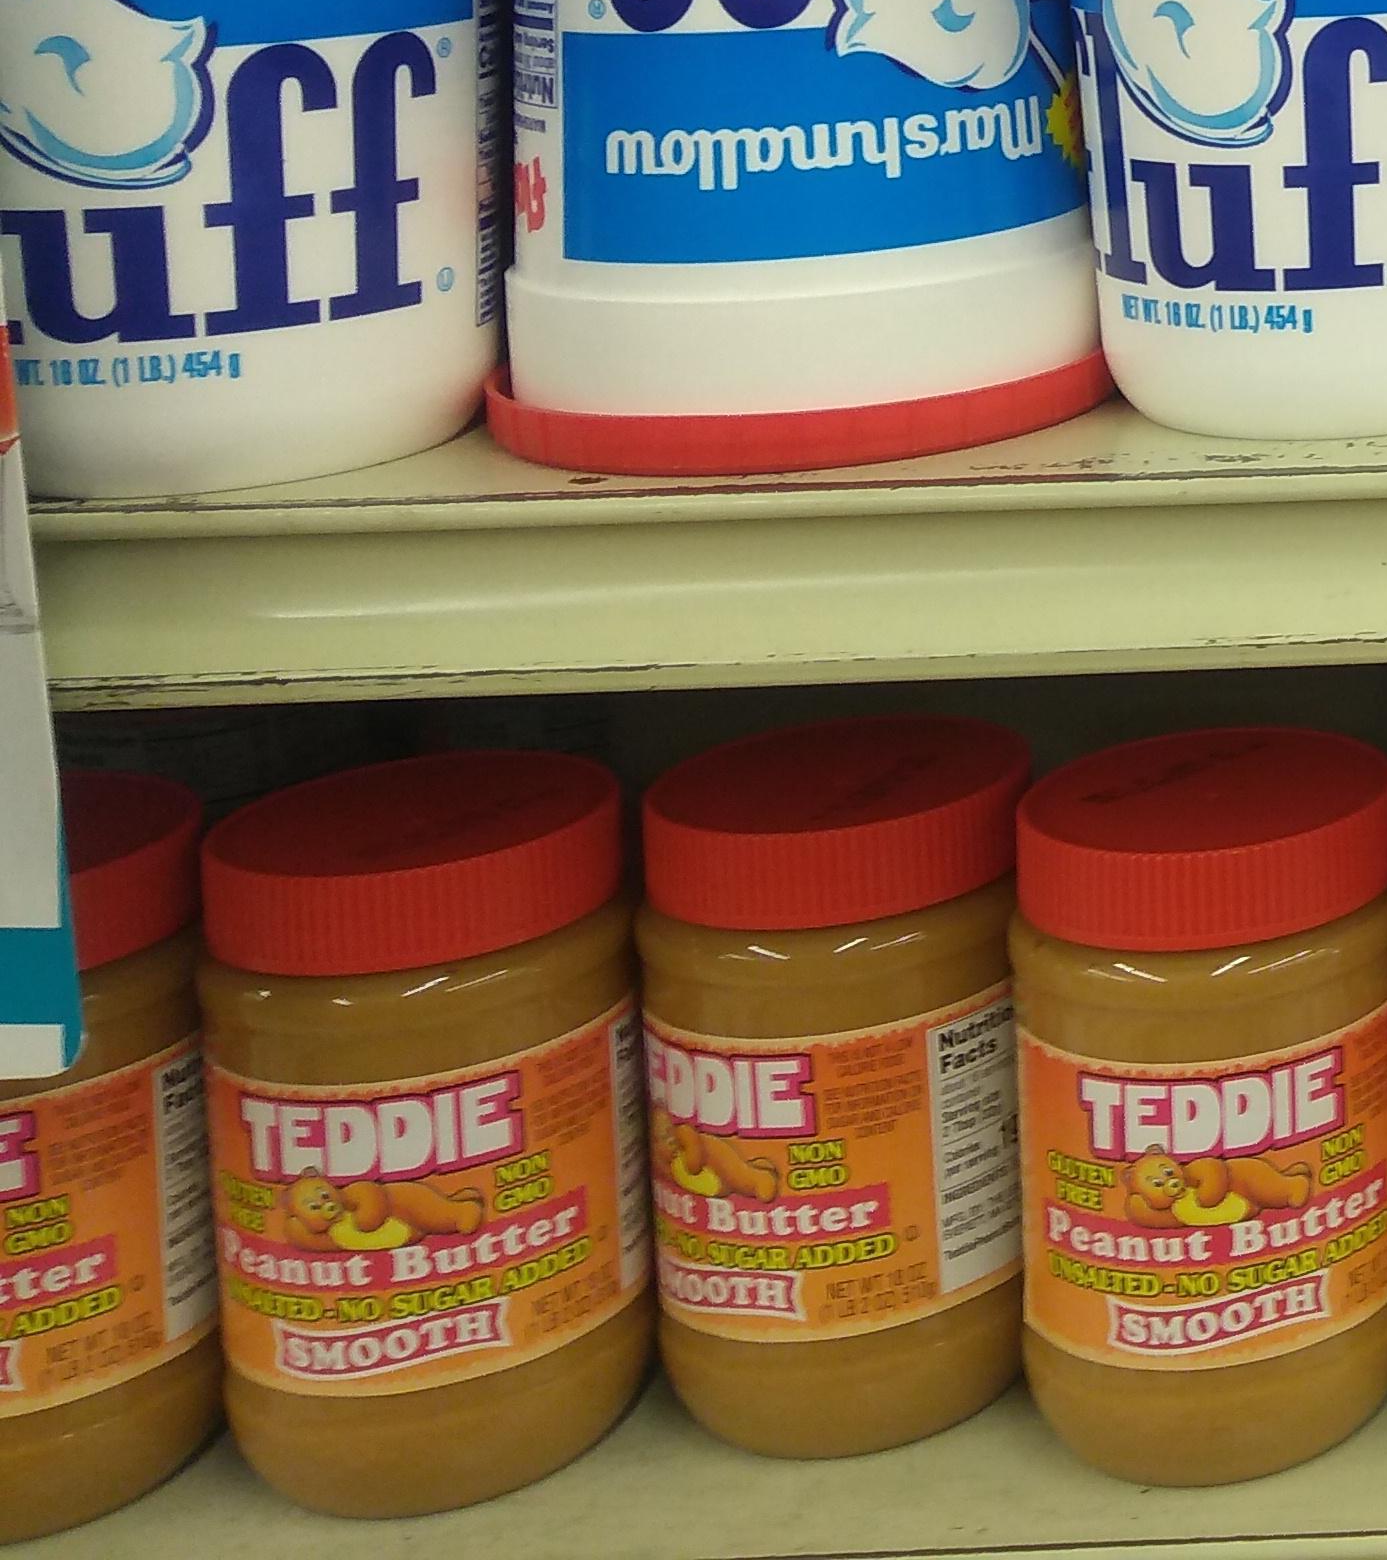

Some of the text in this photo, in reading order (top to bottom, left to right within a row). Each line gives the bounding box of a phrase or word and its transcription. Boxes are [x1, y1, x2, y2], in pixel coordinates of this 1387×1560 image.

[605, 96, 1043, 190] Marshmallow
[0, 31, 437, 344] uff
[939, 1037, 998, 1074] Facts
[645, 1045, 806, 1130] EDDIE
[1081, 1055, 1339, 1154] TEDDIE
[241, 1077, 515, 1177] TEDDIE
[788, 1140, 845, 1165] NON
[493, 1177, 554, 1213] GMO
[495, 1150, 552, 1188] NON
[787, 1165, 849, 1190] GMO
[1047, 1149, 1115, 1189] GLUTEN
[707, 1197, 880, 1237] Butter
[1048, 1178, 1384, 1264] Peanut Butter
[1057, 1182, 1103, 1211] FREE
[222, 1204, 580, 1286] Peanut Butter
[707, 1232, 898, 1271] SUGAR ADDED
[1227, 1248, 1318, 1293] SUGAR
[391, 1235, 594, 1320] SUGAR ADDED
[1120, 1282, 1320, 1345] SMOOTH
[282, 1311, 496, 1375] SMOOTH
